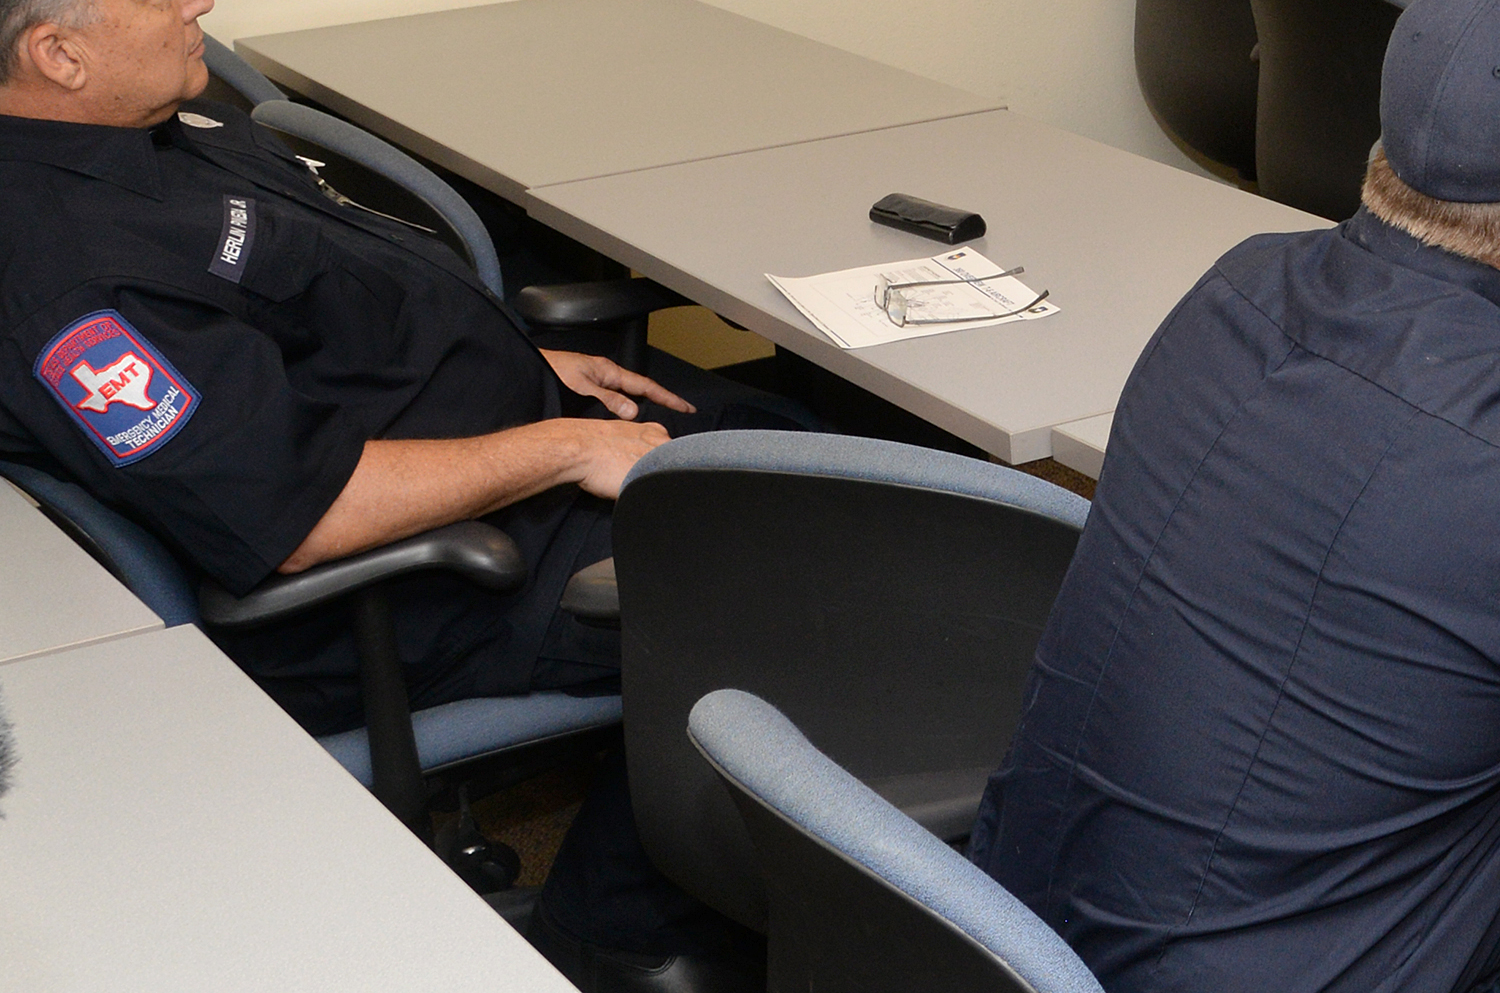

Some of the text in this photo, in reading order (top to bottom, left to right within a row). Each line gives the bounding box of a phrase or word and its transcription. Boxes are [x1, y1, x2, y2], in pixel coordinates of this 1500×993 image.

[57, 325, 99, 358] DEPARTMENT
[98, 362, 141, 400] EMT
[106, 385, 180, 446] EMERGENCY MEDICAL
[125, 405, 179, 449] TECHNICIAN
